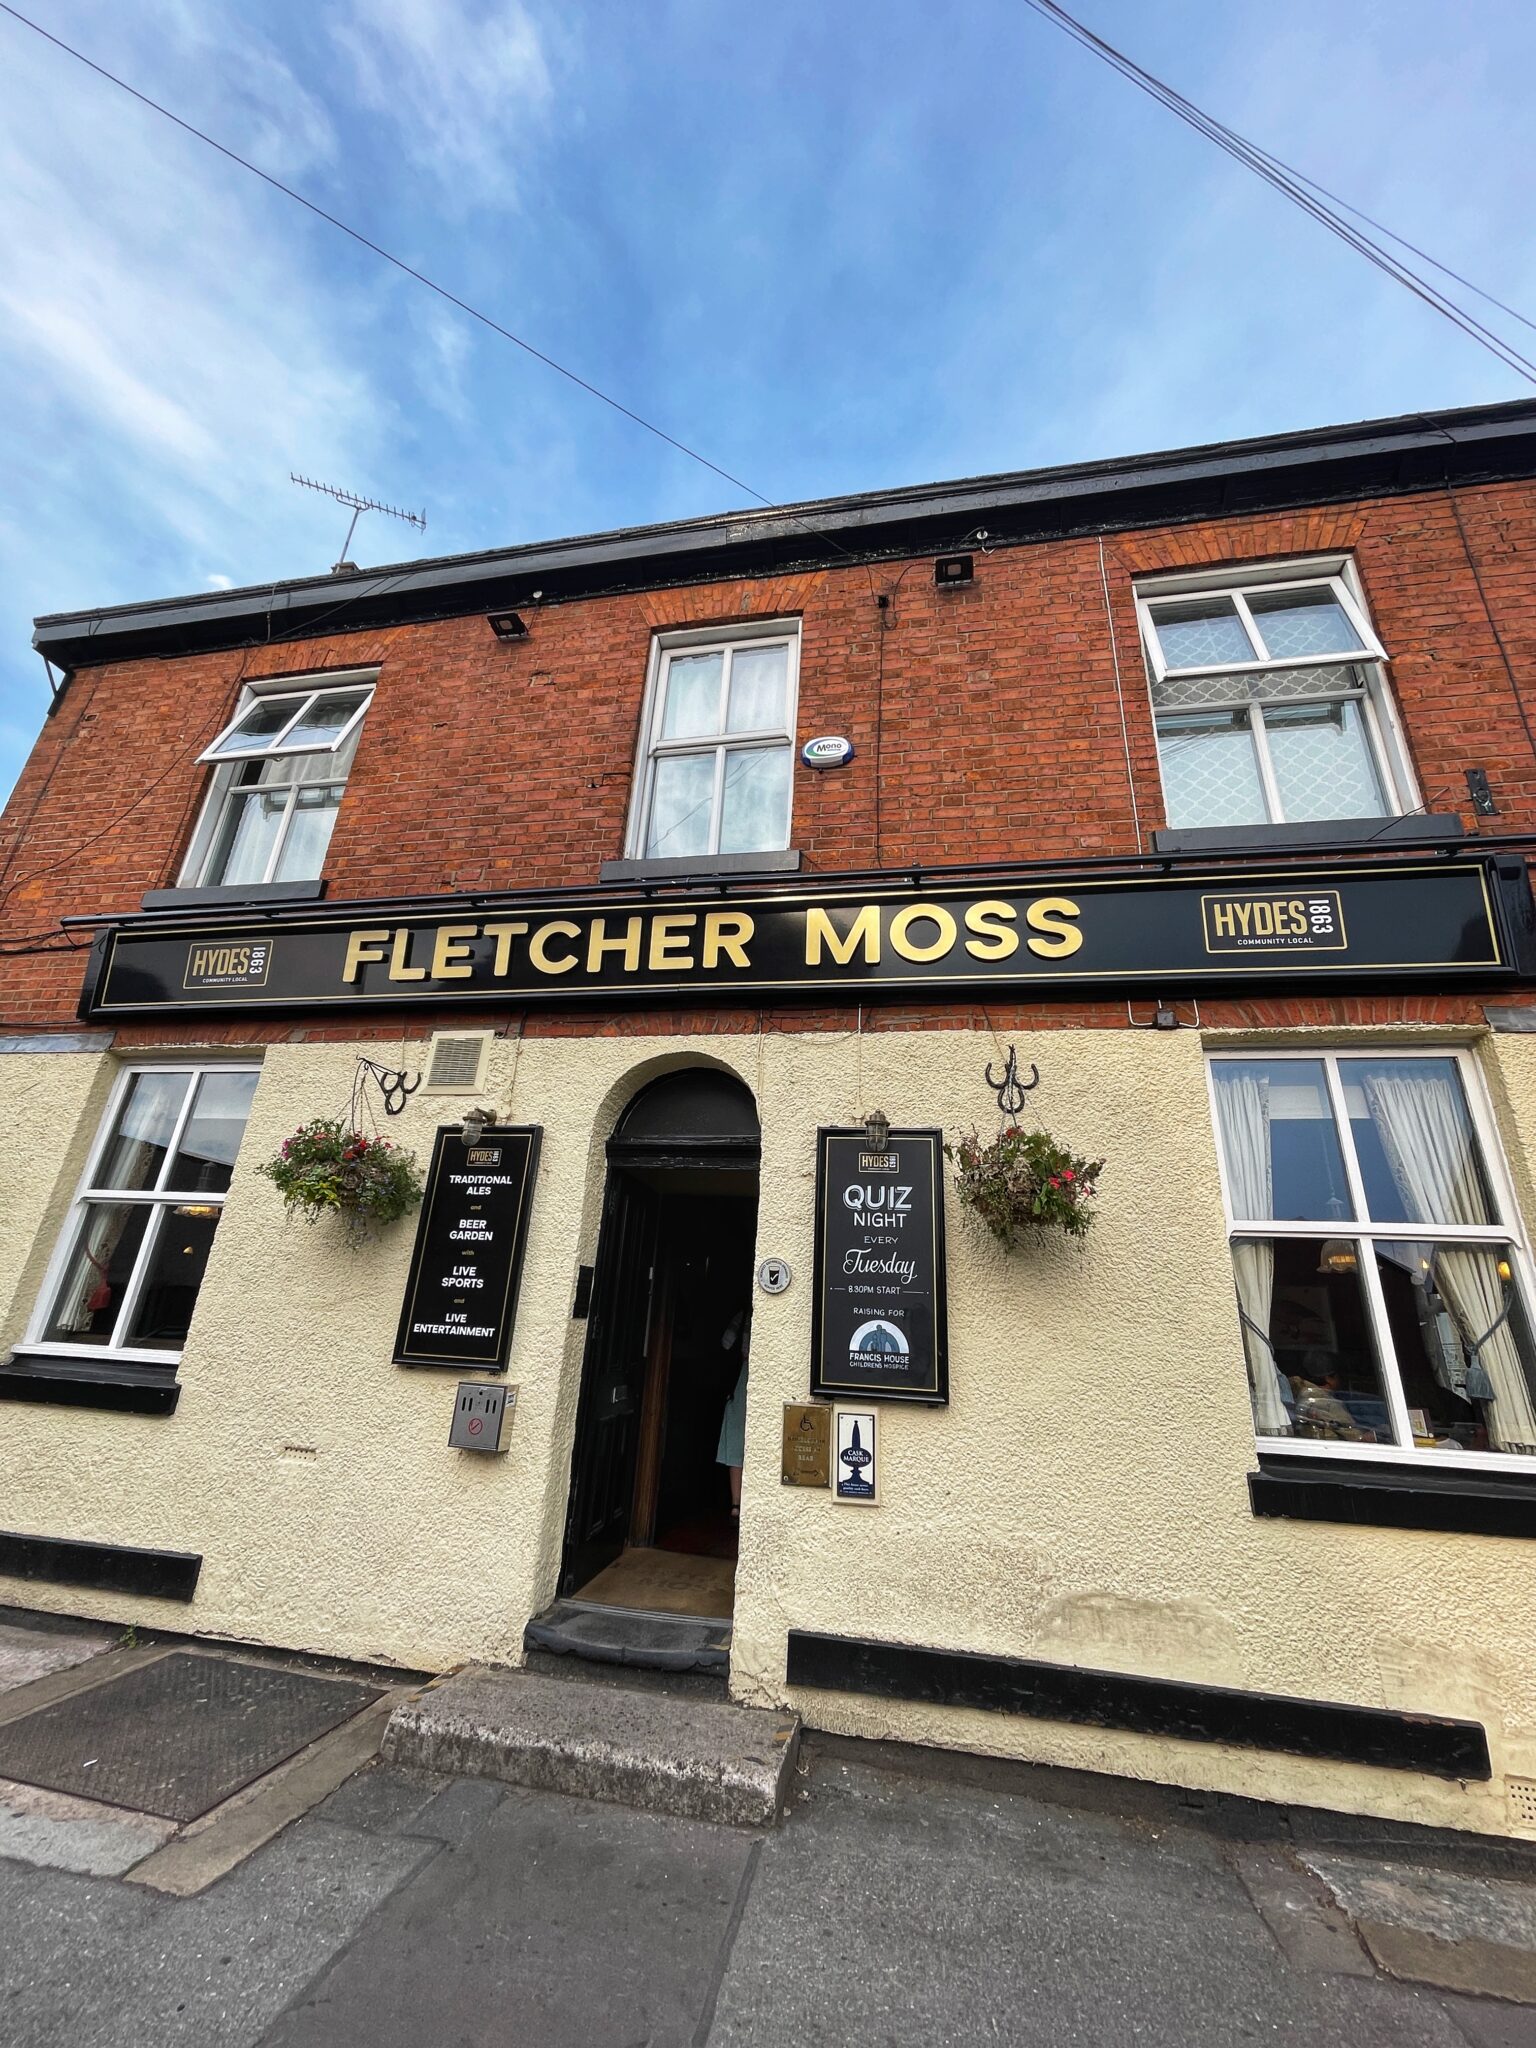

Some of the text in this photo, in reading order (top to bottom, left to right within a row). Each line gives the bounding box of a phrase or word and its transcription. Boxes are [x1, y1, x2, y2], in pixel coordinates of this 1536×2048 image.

[816, 743, 842, 752] Mono
[1213, 900, 1308, 937] HYDES
[1308, 900, 1334, 934] 1863
[342, 897, 1083, 983] FLETCHER MOSS
[1237, 938, 1285, 946] COMMUNITY
[192, 947, 251, 976] HYDES
[249, 946, 266, 974] 1863
[470, 1151, 494, 1161] HYDES
[862, 1156, 889, 1167] HYDES
[449, 1175, 513, 1184] TRADITIONAL
[466, 1186, 492, 1195] ALES
[842, 1184, 913, 1211] QUIZ
[459, 1219, 487, 1229] BEER
[854, 1212, 907, 1228] NIGHT
[449, 1230, 494, 1241] GARDEN
[864, 1236, 899, 1244] EVERY
[452, 1266, 477, 1276] LIVE
[842, 1248, 918, 1285] Tuesday
[441, 1277, 484, 1288] SPORTS
[848, 1285, 901, 1295] 8.30PM START
[853, 1307, 905, 1317] RAISING FOR
[445, 1313, 468, 1323] LIVE
[413, 1323, 496, 1337] ENTERTAINMENT
[850, 1352, 910, 1364] FRANCIS HOUSE
